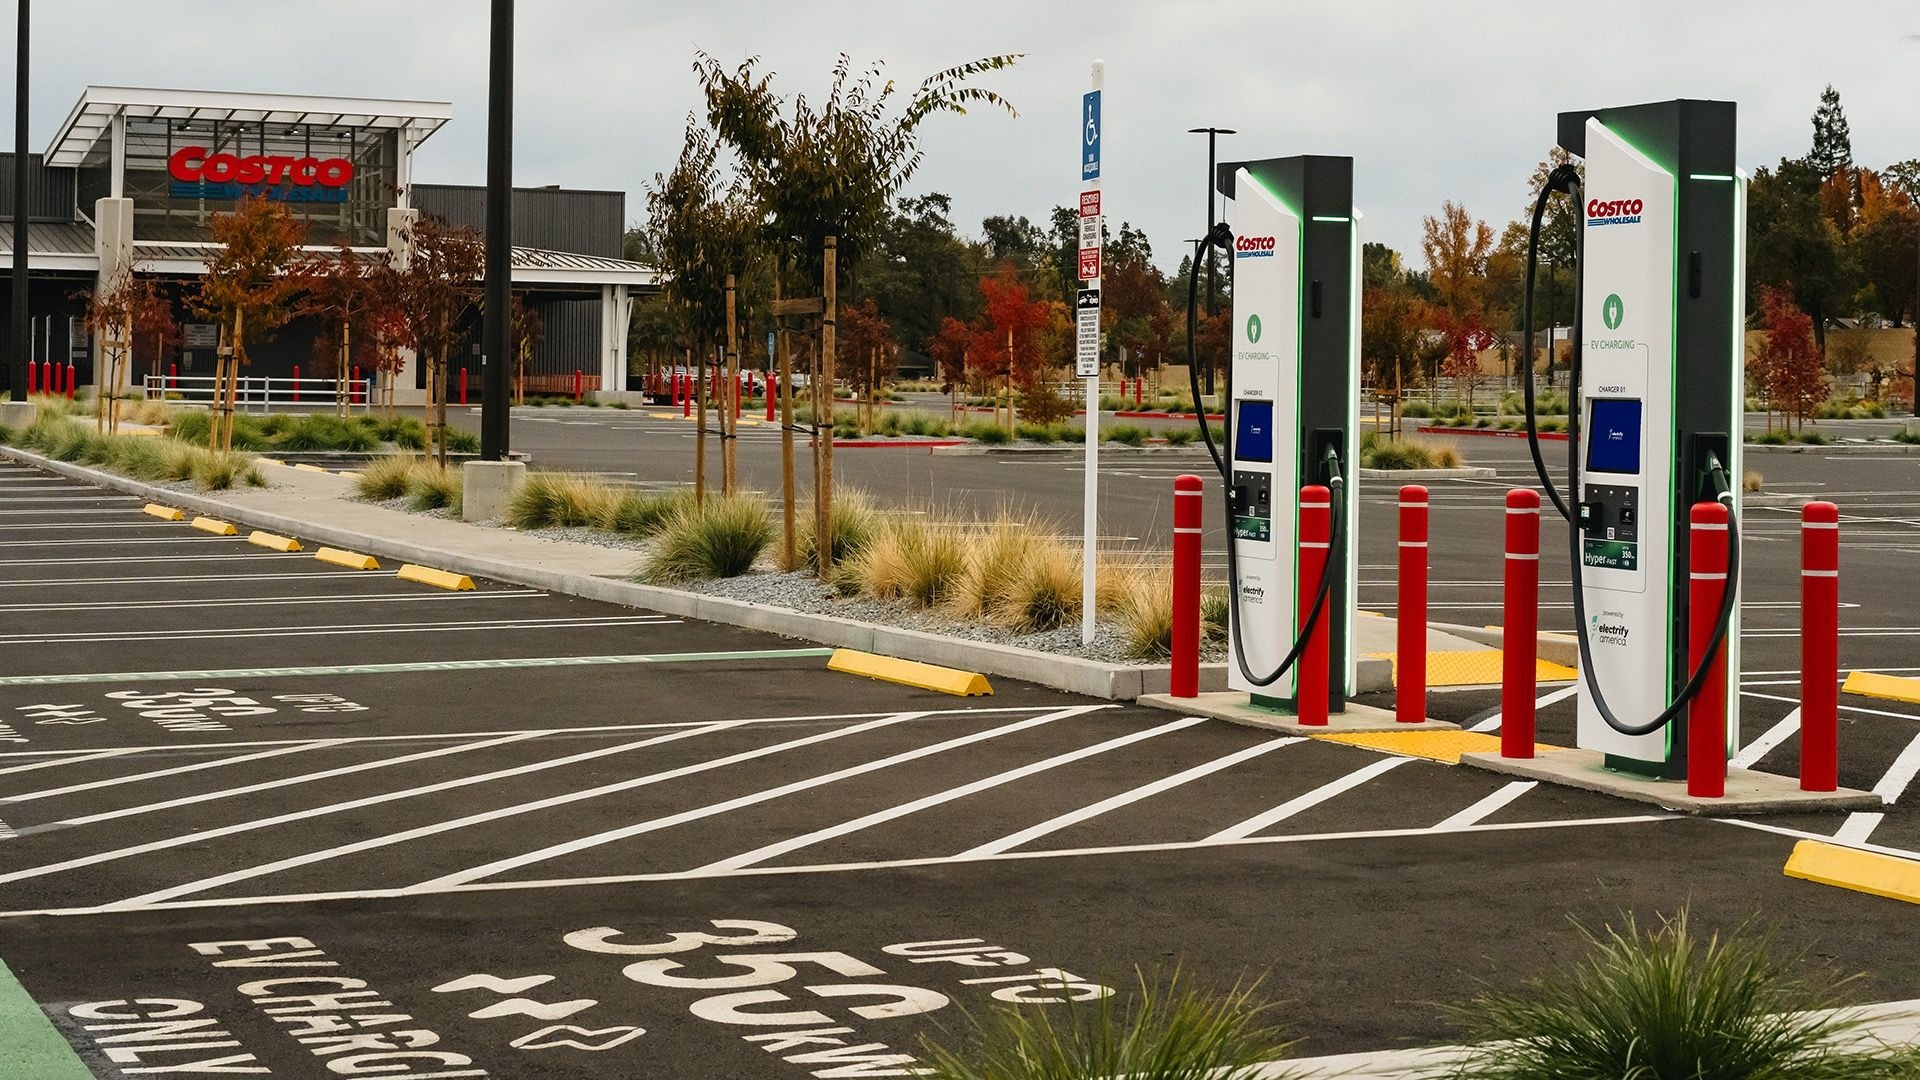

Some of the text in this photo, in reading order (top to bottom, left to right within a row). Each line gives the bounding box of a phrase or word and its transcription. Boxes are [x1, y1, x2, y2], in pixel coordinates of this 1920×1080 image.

[168, 146, 354, 187] COSTCO
[1587, 199, 1643, 218] COSTCO
[1603, 216, 1641, 225] WHOLESALE
[1236, 236, 1276, 251] COSTCO
[1590, 340, 1635, 350] EV CHARGING
[1243, 586, 1264, 598] electrify
[1598, 624, 1629, 638] electrify
[187, 936, 339, 968] EV
[881, 938, 1031, 967] UP
[68, 998, 272, 1074] ONLY
